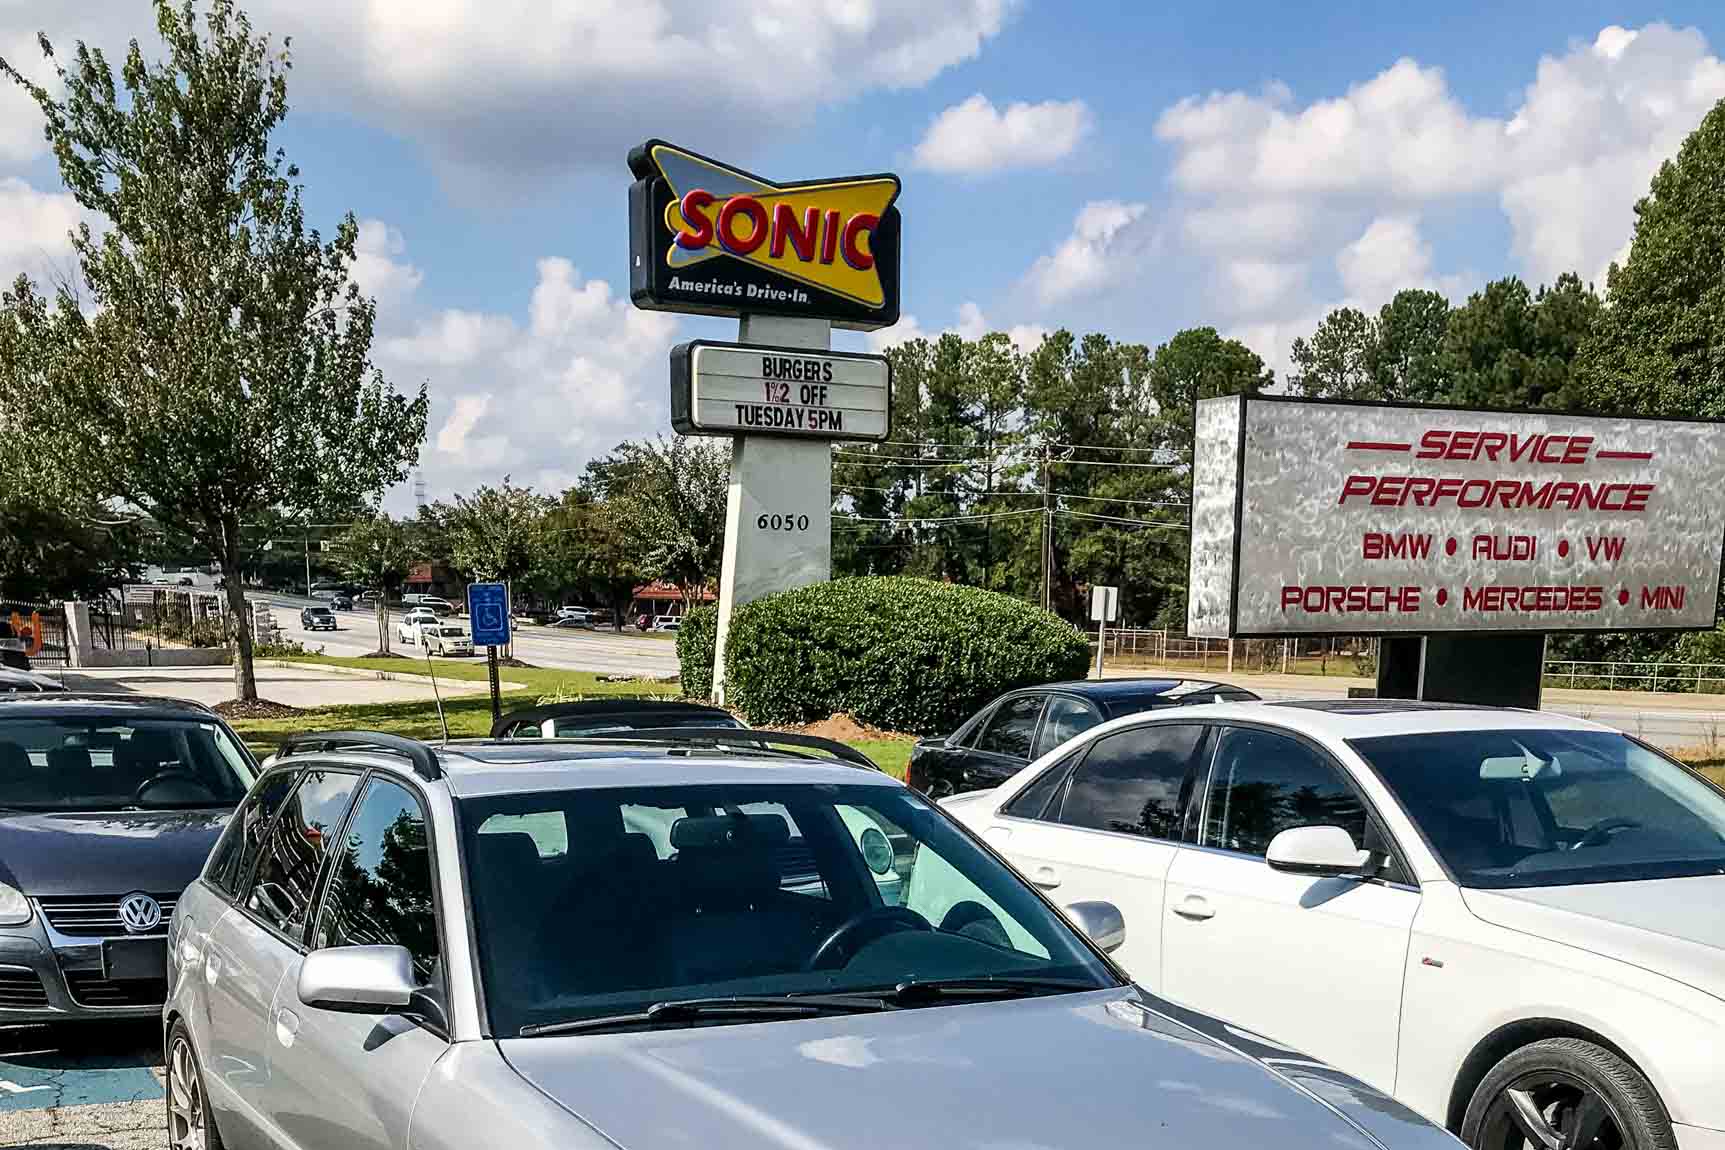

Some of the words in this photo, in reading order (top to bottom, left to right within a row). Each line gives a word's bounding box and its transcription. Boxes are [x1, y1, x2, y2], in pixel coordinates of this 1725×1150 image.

[672, 188, 881, 272] SONIC
[668, 276, 743, 296] America's
[762, 357, 832, 381] BURGERS
[800, 384, 827, 405] OFF
[736, 404, 804, 428] TUESDAY
[808, 408, 842, 431] 5PM
[1416, 430, 1595, 464] SERVICE
[1337, 475, 1656, 512] PERFORMANCE
[757, 514, 809, 531] 6050
[1363, 533, 1432, 560] BMW
[1472, 535, 1536, 561] AUDI
[1585, 537, 1626, 561] VW
[1281, 586, 1421, 613] PORSCHE
[1463, 586, 1603, 612] MERCEDES
[1640, 585, 1686, 610] MINI
